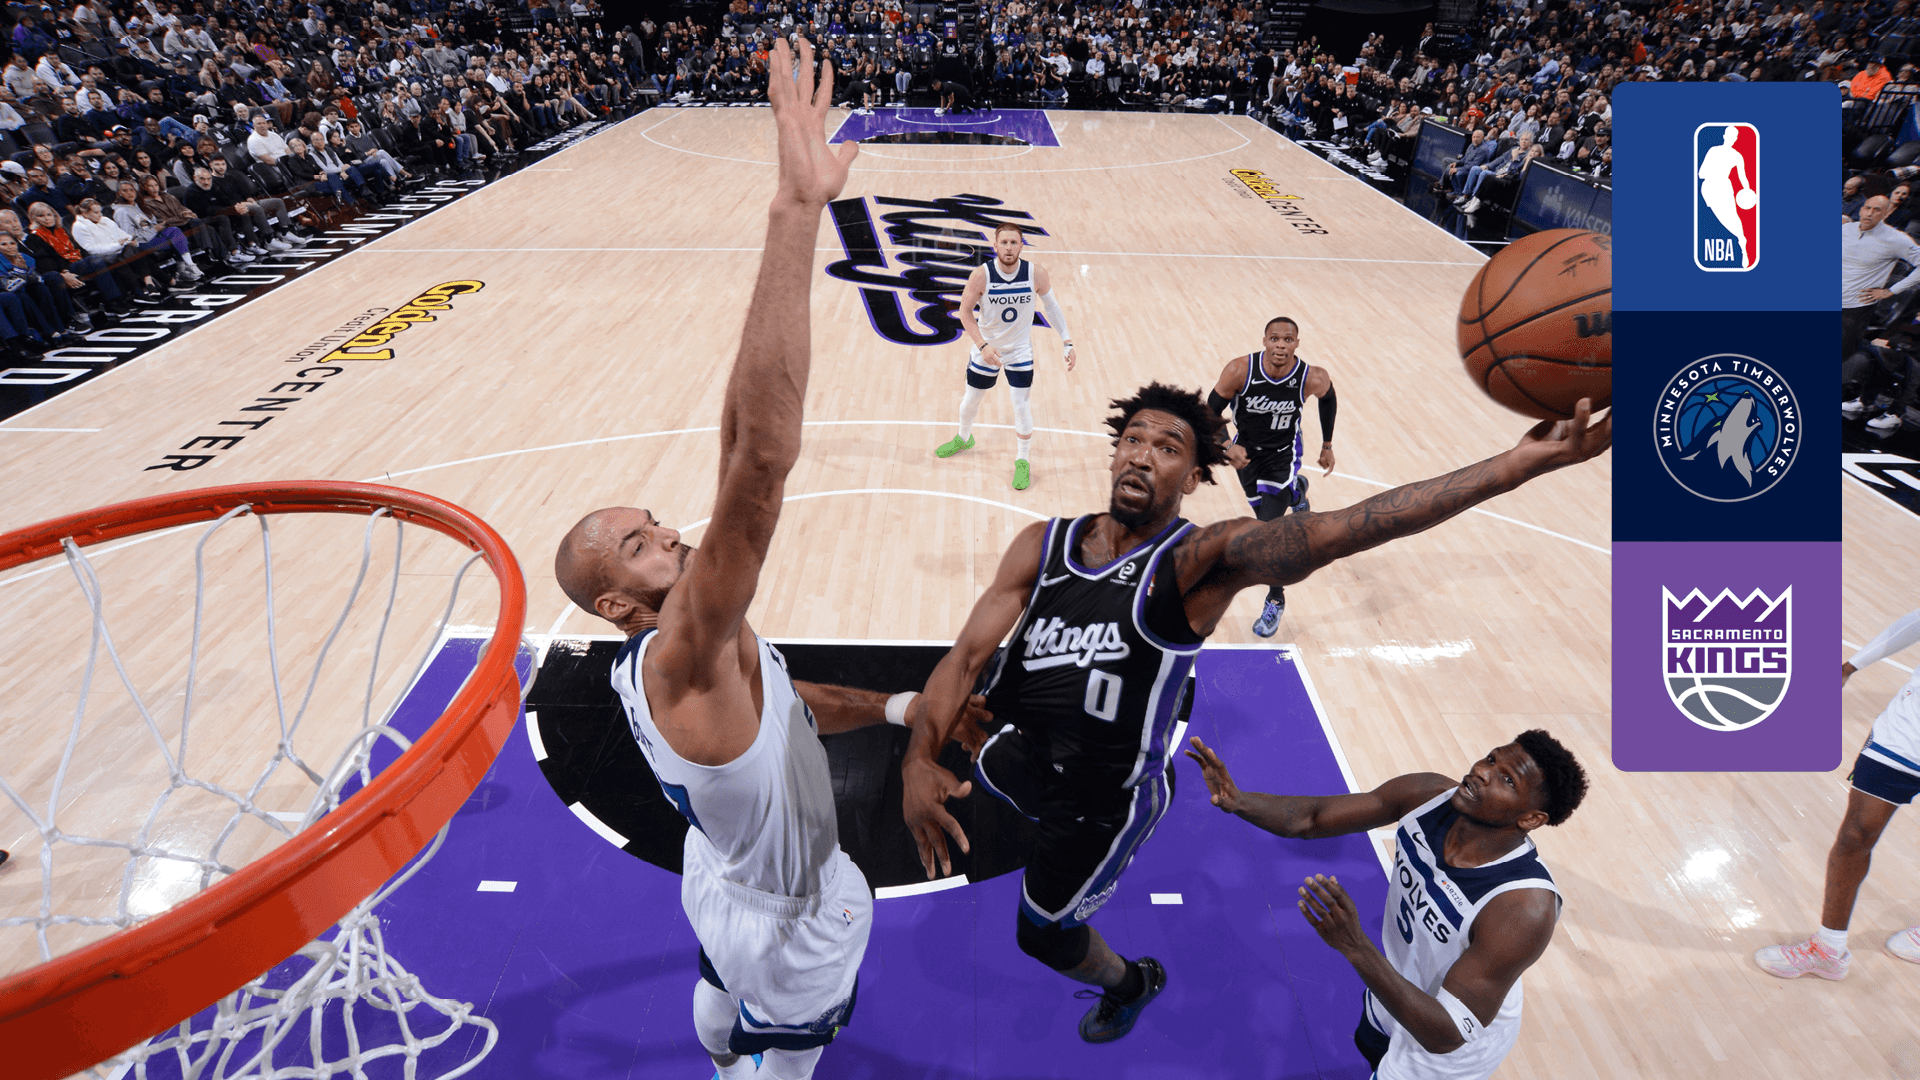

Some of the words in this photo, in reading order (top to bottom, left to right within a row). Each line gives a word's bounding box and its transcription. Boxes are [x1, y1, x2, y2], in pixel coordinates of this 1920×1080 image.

[1265, 200, 1330, 235] CENTER
[211, 179, 486, 285] SACRAMENTO
[988, 295, 1031, 305] WOLVES
[333, 307, 389, 333] Credit
[1001, 306, 1018, 323] 0
[0, 294, 248, 385] PROUD
[284, 335, 347, 363] Union
[142, 366, 344, 471] CENTER
[1245, 395, 1296, 415] Kings
[1270, 414, 1293, 430] 18
[1022, 616, 1130, 672] Kings
[1084, 668, 1123, 722] 0
[1445, 884, 1464, 907] sezzle
[1396, 894, 1415, 945] 5
[1463, 1017, 1474, 1034] 5
